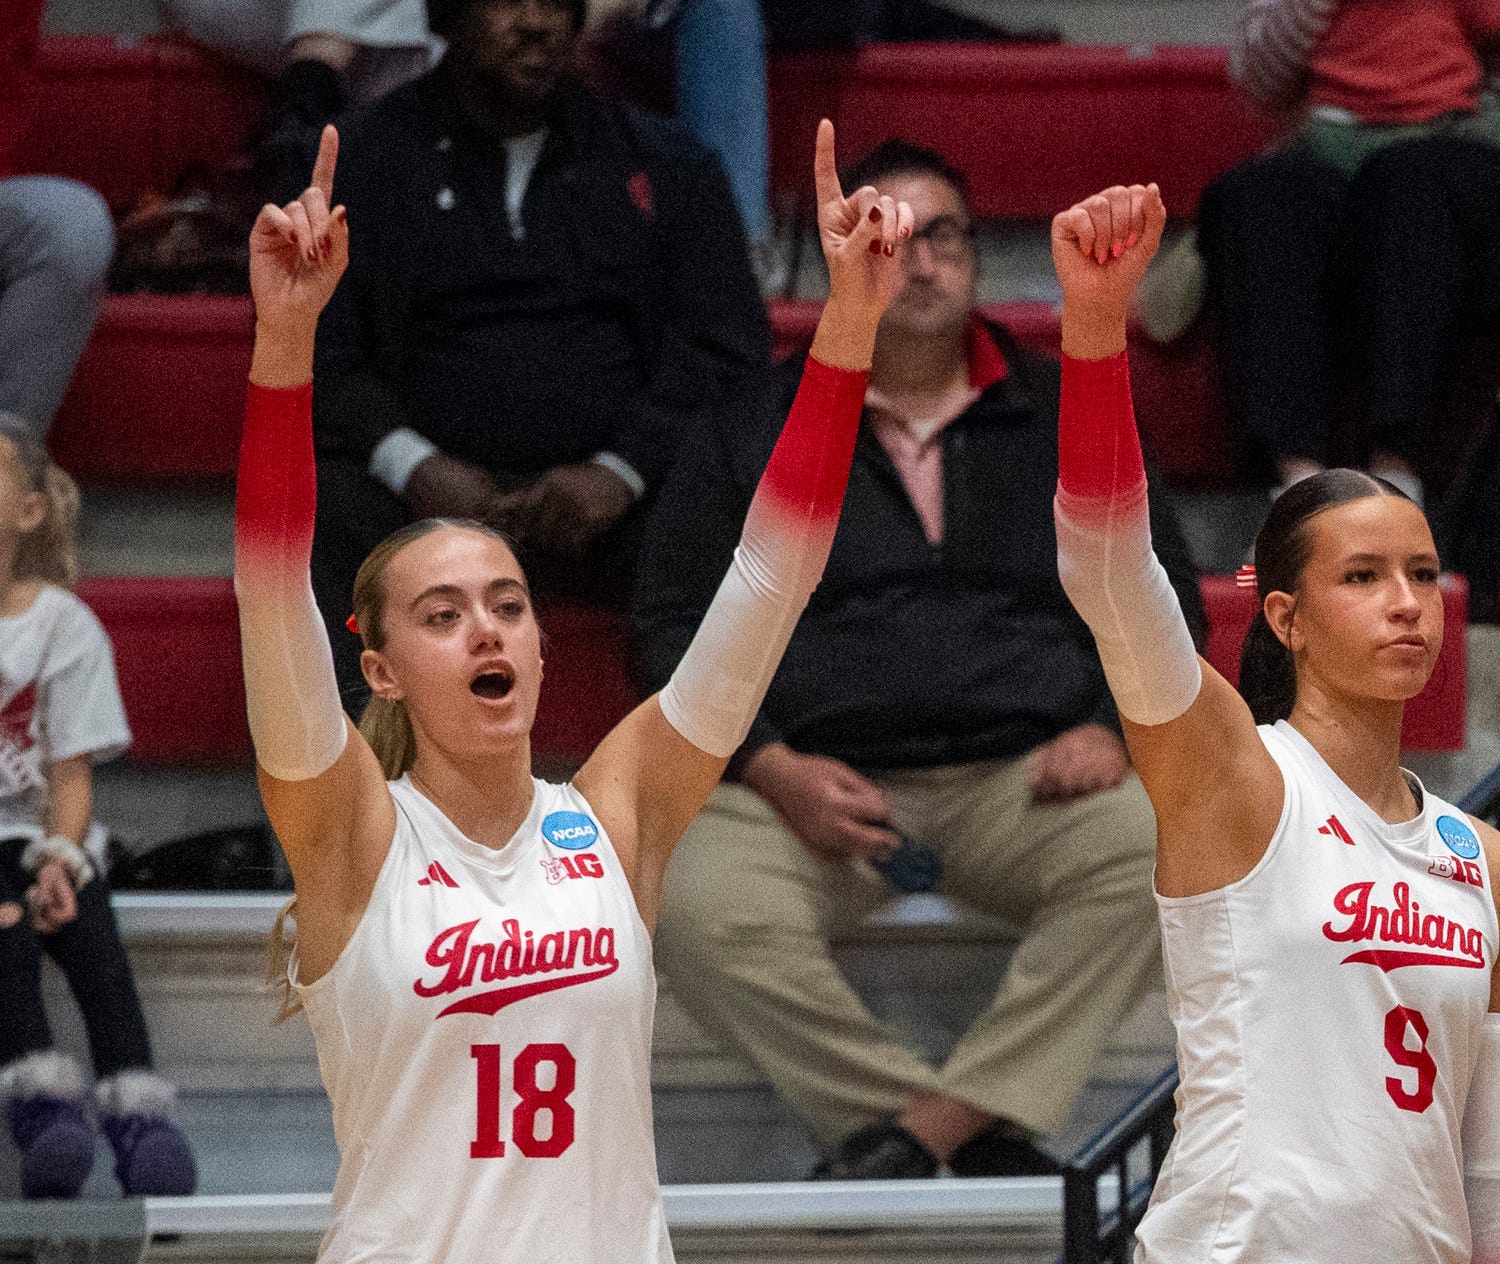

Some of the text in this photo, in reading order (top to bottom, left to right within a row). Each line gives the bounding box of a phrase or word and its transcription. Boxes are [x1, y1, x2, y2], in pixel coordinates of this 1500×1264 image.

[552, 825, 596, 841] NCAA
[413, 918, 620, 999] Indiana
[1322, 881, 1485, 959] Indiana
[1384, 1004, 1438, 1114] 9
[470, 1043, 576, 1159] 18
